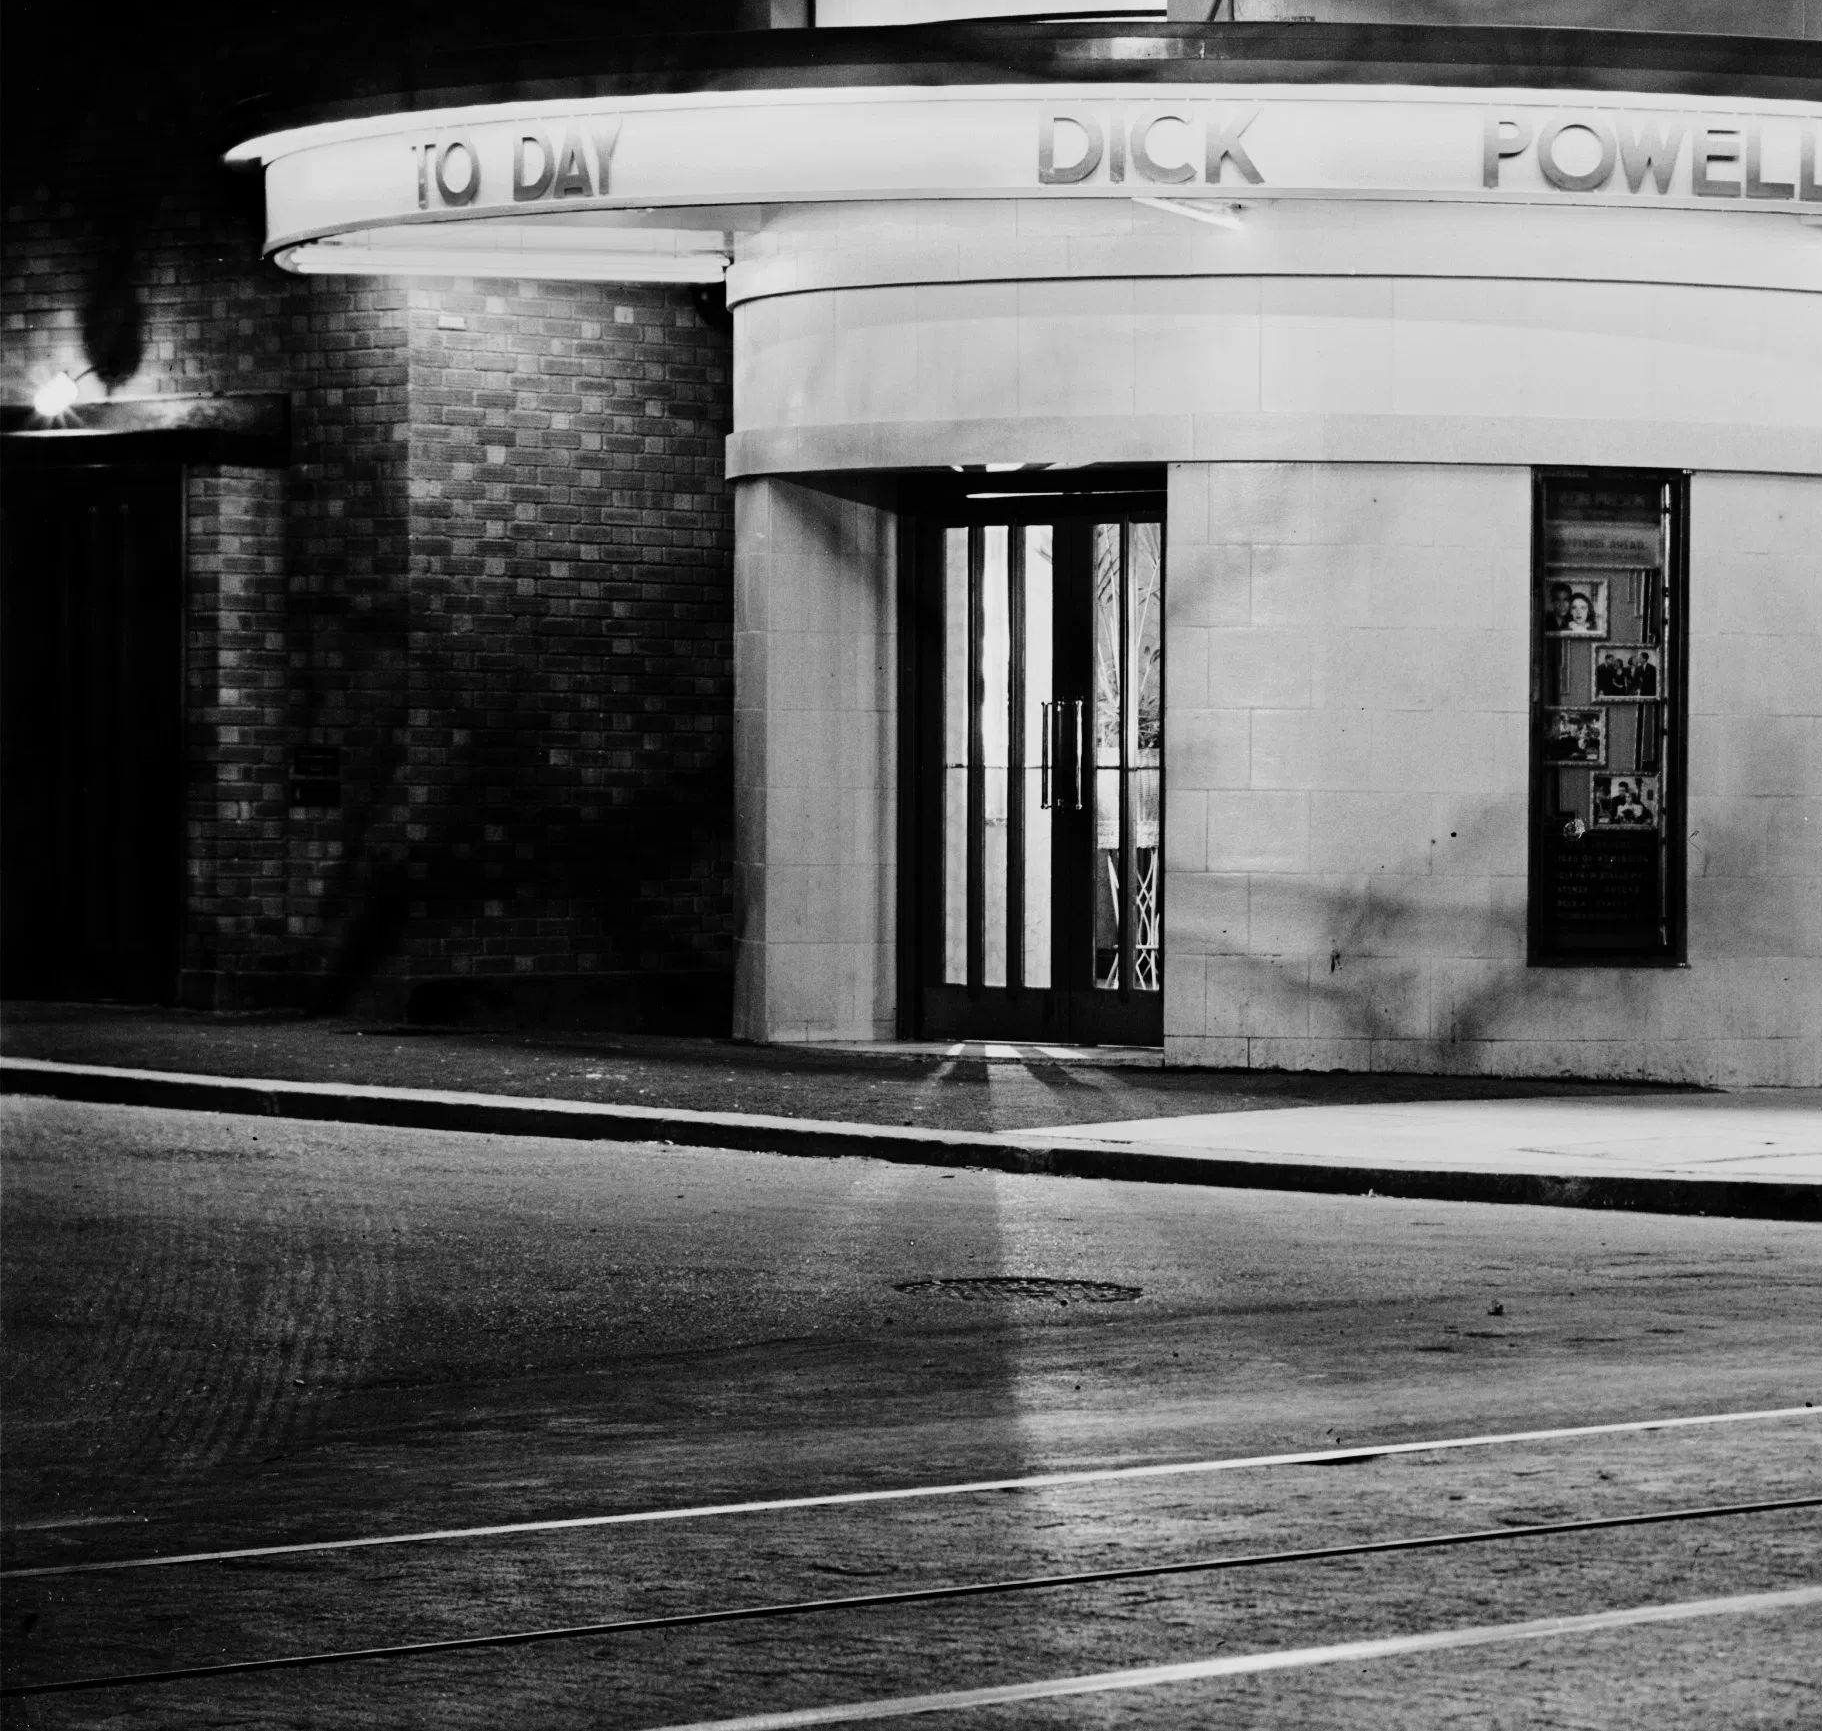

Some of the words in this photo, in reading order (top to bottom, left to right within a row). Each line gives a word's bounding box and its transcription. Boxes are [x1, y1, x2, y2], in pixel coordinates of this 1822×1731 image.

[411, 138, 480, 209] TO
[511, 120, 622, 202] DAY
[1037, 101, 1266, 186] DICK
